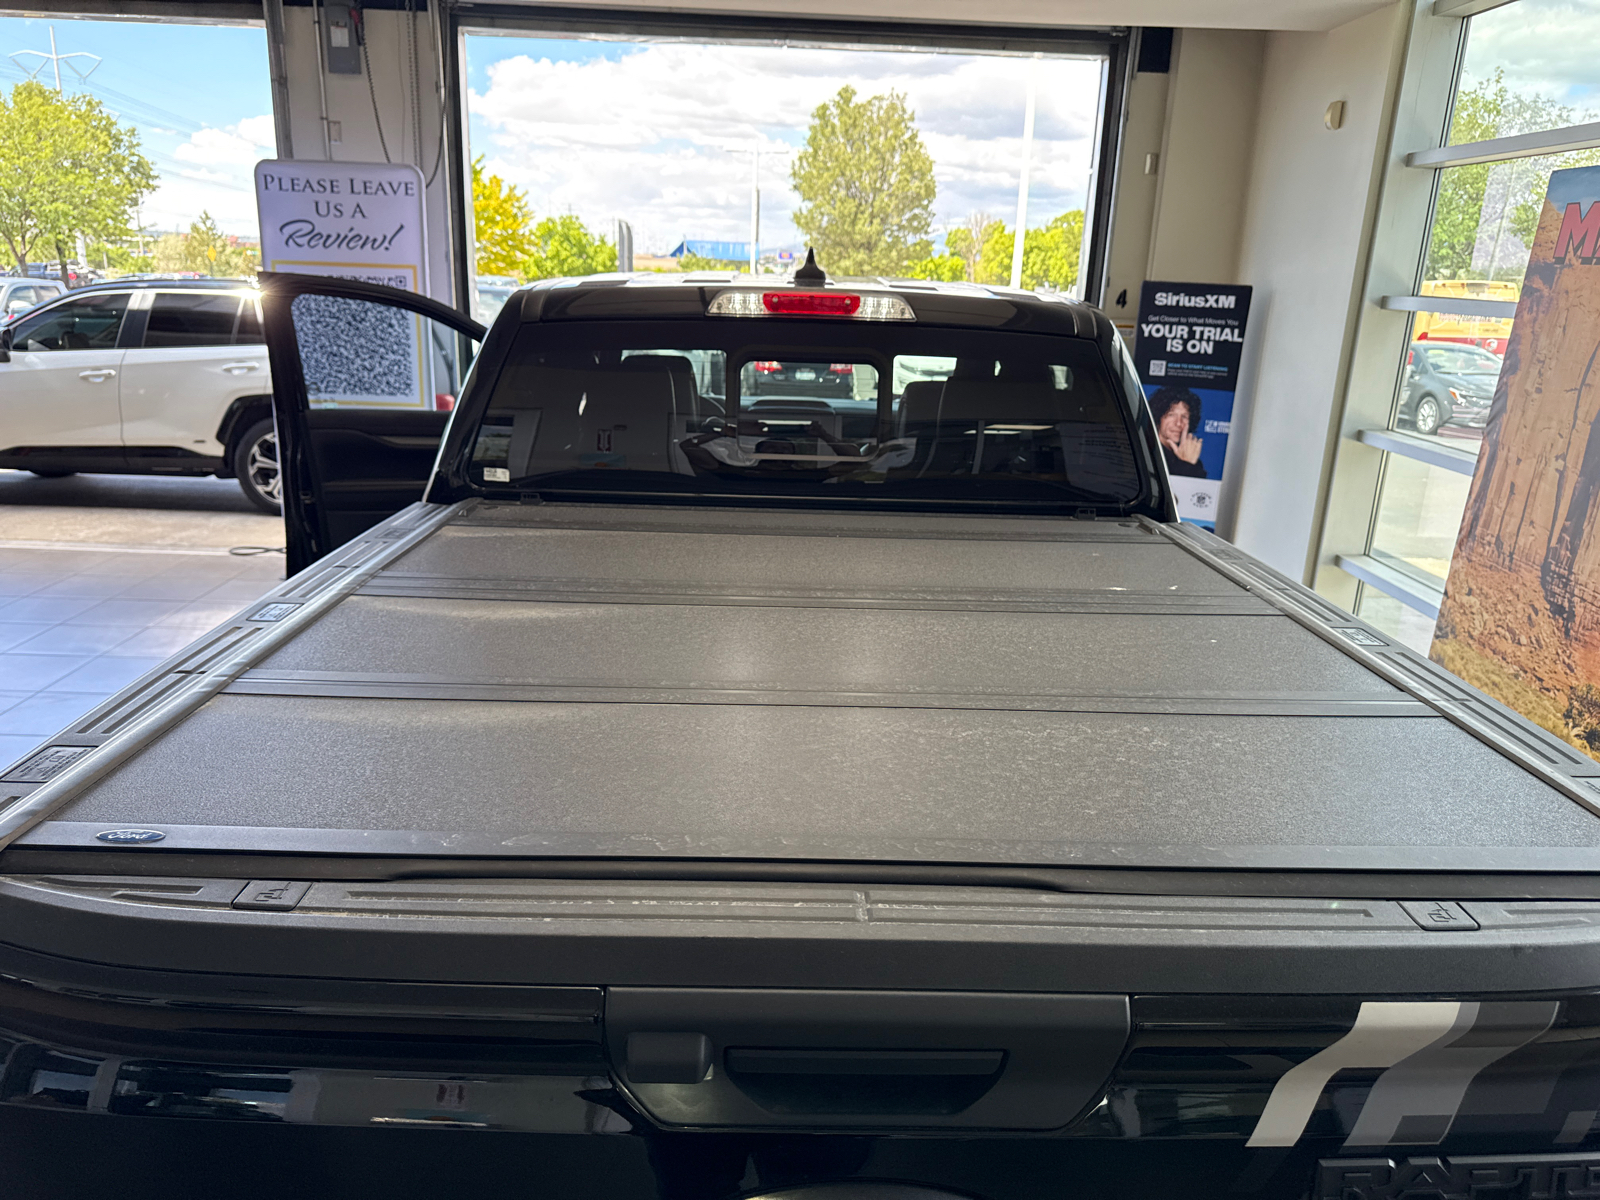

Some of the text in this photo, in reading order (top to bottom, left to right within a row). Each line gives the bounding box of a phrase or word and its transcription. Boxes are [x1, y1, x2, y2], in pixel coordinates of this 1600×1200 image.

[351, 203, 367, 219] A
[279, 219, 405, 251] Review!
[1116, 289, 1127, 309] 4
[1154, 292, 1236, 309] SiriusXM
[1148, 315, 1159, 323] Get
[1160, 315, 1179, 323] Closer
[1205, 318, 1226, 326] Moves
[1226, 319, 1239, 327] You
[1141, 323, 1189, 339] YOUR
[1192, 326, 1243, 342] TRIAL
[1166, 339, 1214, 354] IS ON
